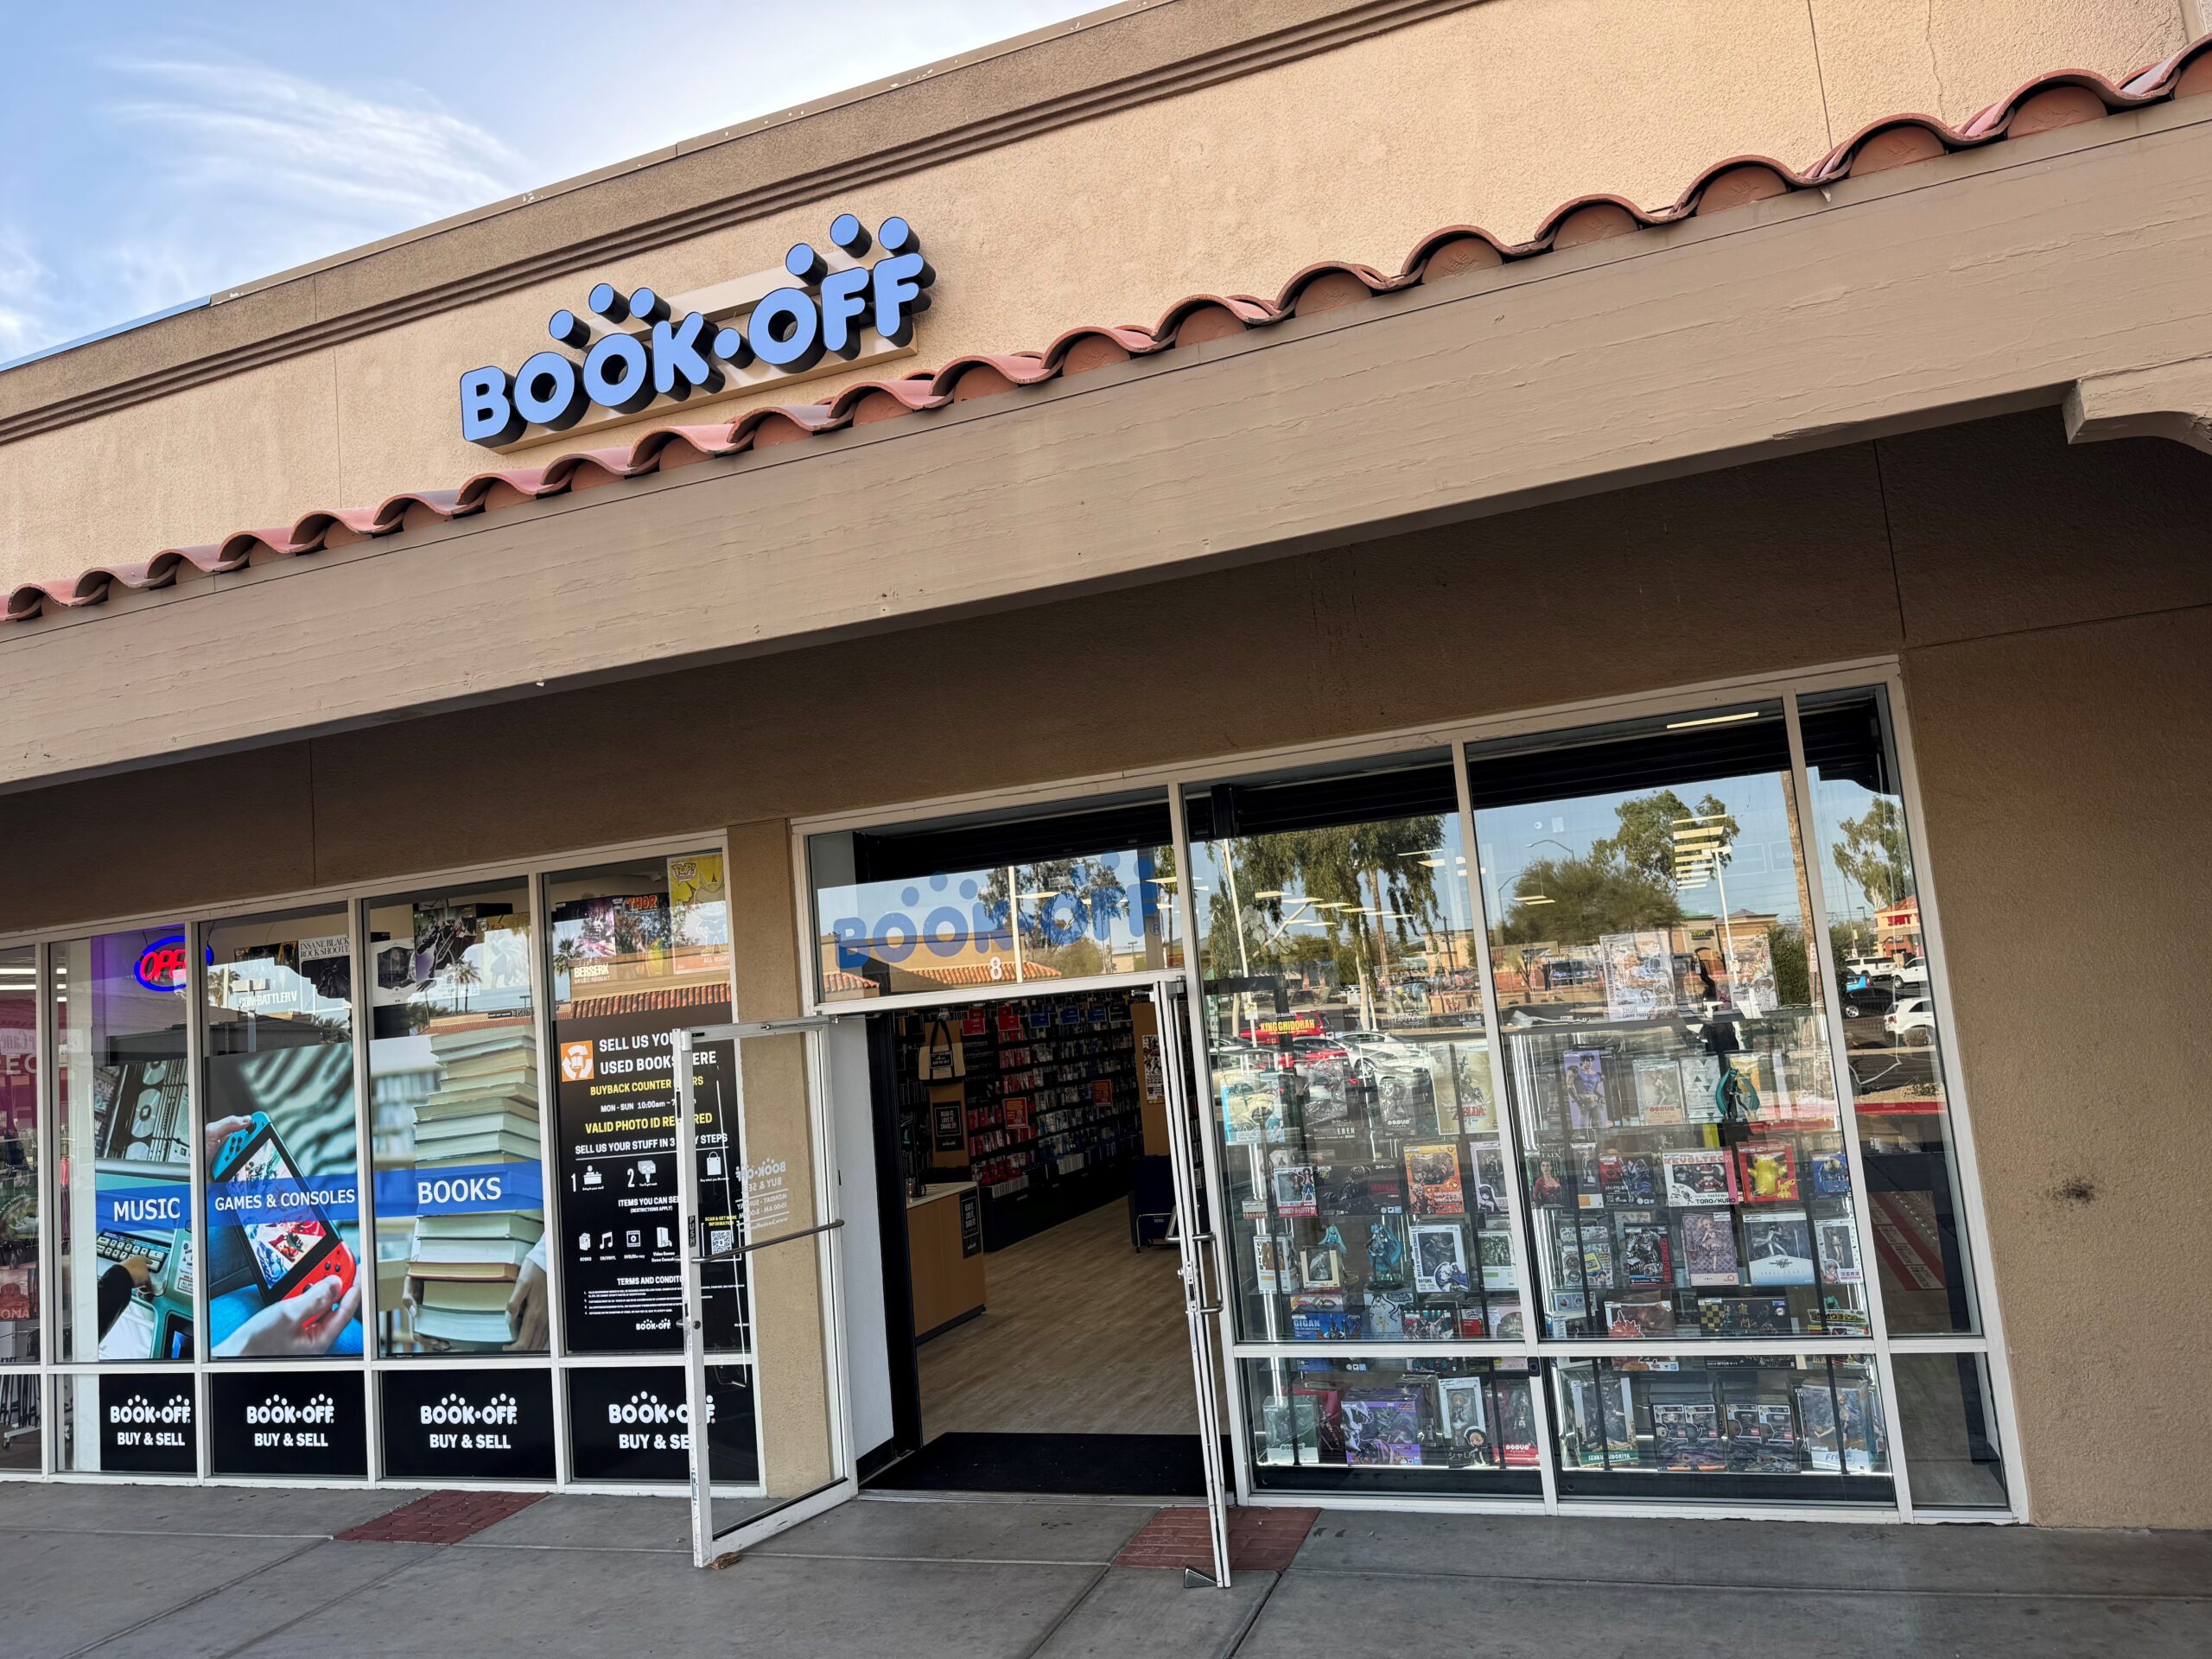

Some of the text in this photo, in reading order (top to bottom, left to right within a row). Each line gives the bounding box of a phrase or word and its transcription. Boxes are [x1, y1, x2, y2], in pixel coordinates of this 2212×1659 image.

[626, 894, 658, 912] THOR
[327, 938, 350, 947] BLACK
[301, 950, 320, 958] ROCK
[140, 949, 187, 982] OPE
[574, 963, 609, 978] BERSERK
[989, 957, 1002, 981] 8
[1260, 1020, 1314, 1033] KING GHIDORAH
[599, 1039, 629, 1052] SELL
[632, 1035, 649, 1049] US
[600, 1059, 633, 1075] USED
[692, 1051, 717, 1065] ERE
[590, 1079, 671, 1096] BUYBACK COUNTER
[601, 1104, 617, 1113] MON
[620, 1102, 634, 1110] SUN
[637, 1101, 665, 1110] 10:00am
[585, 1112, 713, 1134] VALID PHOTO ID RERED
[575, 1136, 676, 1155] SELL US YOUR STUFF IN 3
[700, 1133, 728, 1144] STEPS
[1664, 1155, 1733, 1165] REVOLTECH
[570, 1173, 577, 1192] 1
[626, 1167, 636, 1188] 2
[417, 1177, 502, 1205] BOOKS
[214, 1188, 356, 1211] GAMES & CONSOLES
[619, 1198, 639, 1207] ITEMS
[654, 1196, 668, 1205] CAN
[114, 1198, 181, 1222] MUSIC
[617, 1277, 640, 1286] TERMS
[640, 1276, 654, 1285] AND
[1294, 1319, 1320, 1328] GIGAN
[118, 1432, 185, 1446] BUY & SELL
[254, 1433, 328, 1447] BUY & SELL
[429, 1434, 512, 1449] BUY & SELL
[619, 1433, 690, 1449] BUY & SE
